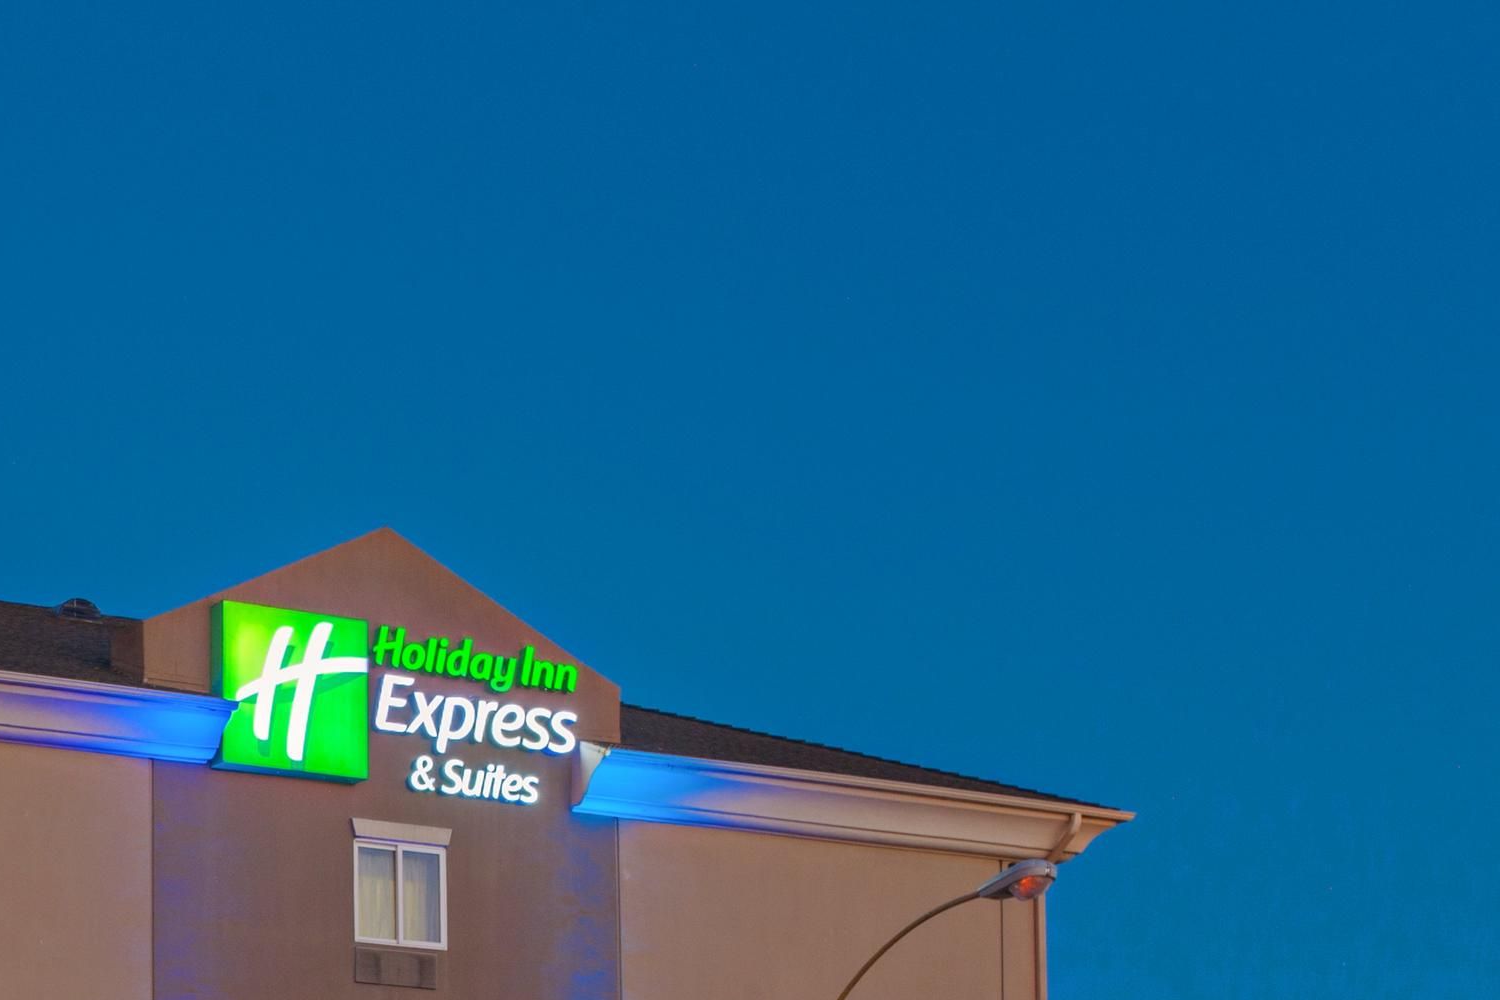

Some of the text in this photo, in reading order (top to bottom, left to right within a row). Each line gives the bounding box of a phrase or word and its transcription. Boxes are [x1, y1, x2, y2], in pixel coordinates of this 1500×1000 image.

[373, 624, 578, 693] Holiday Inn
[375, 673, 578, 754] Express
[411, 755, 539, 803] & Suites
